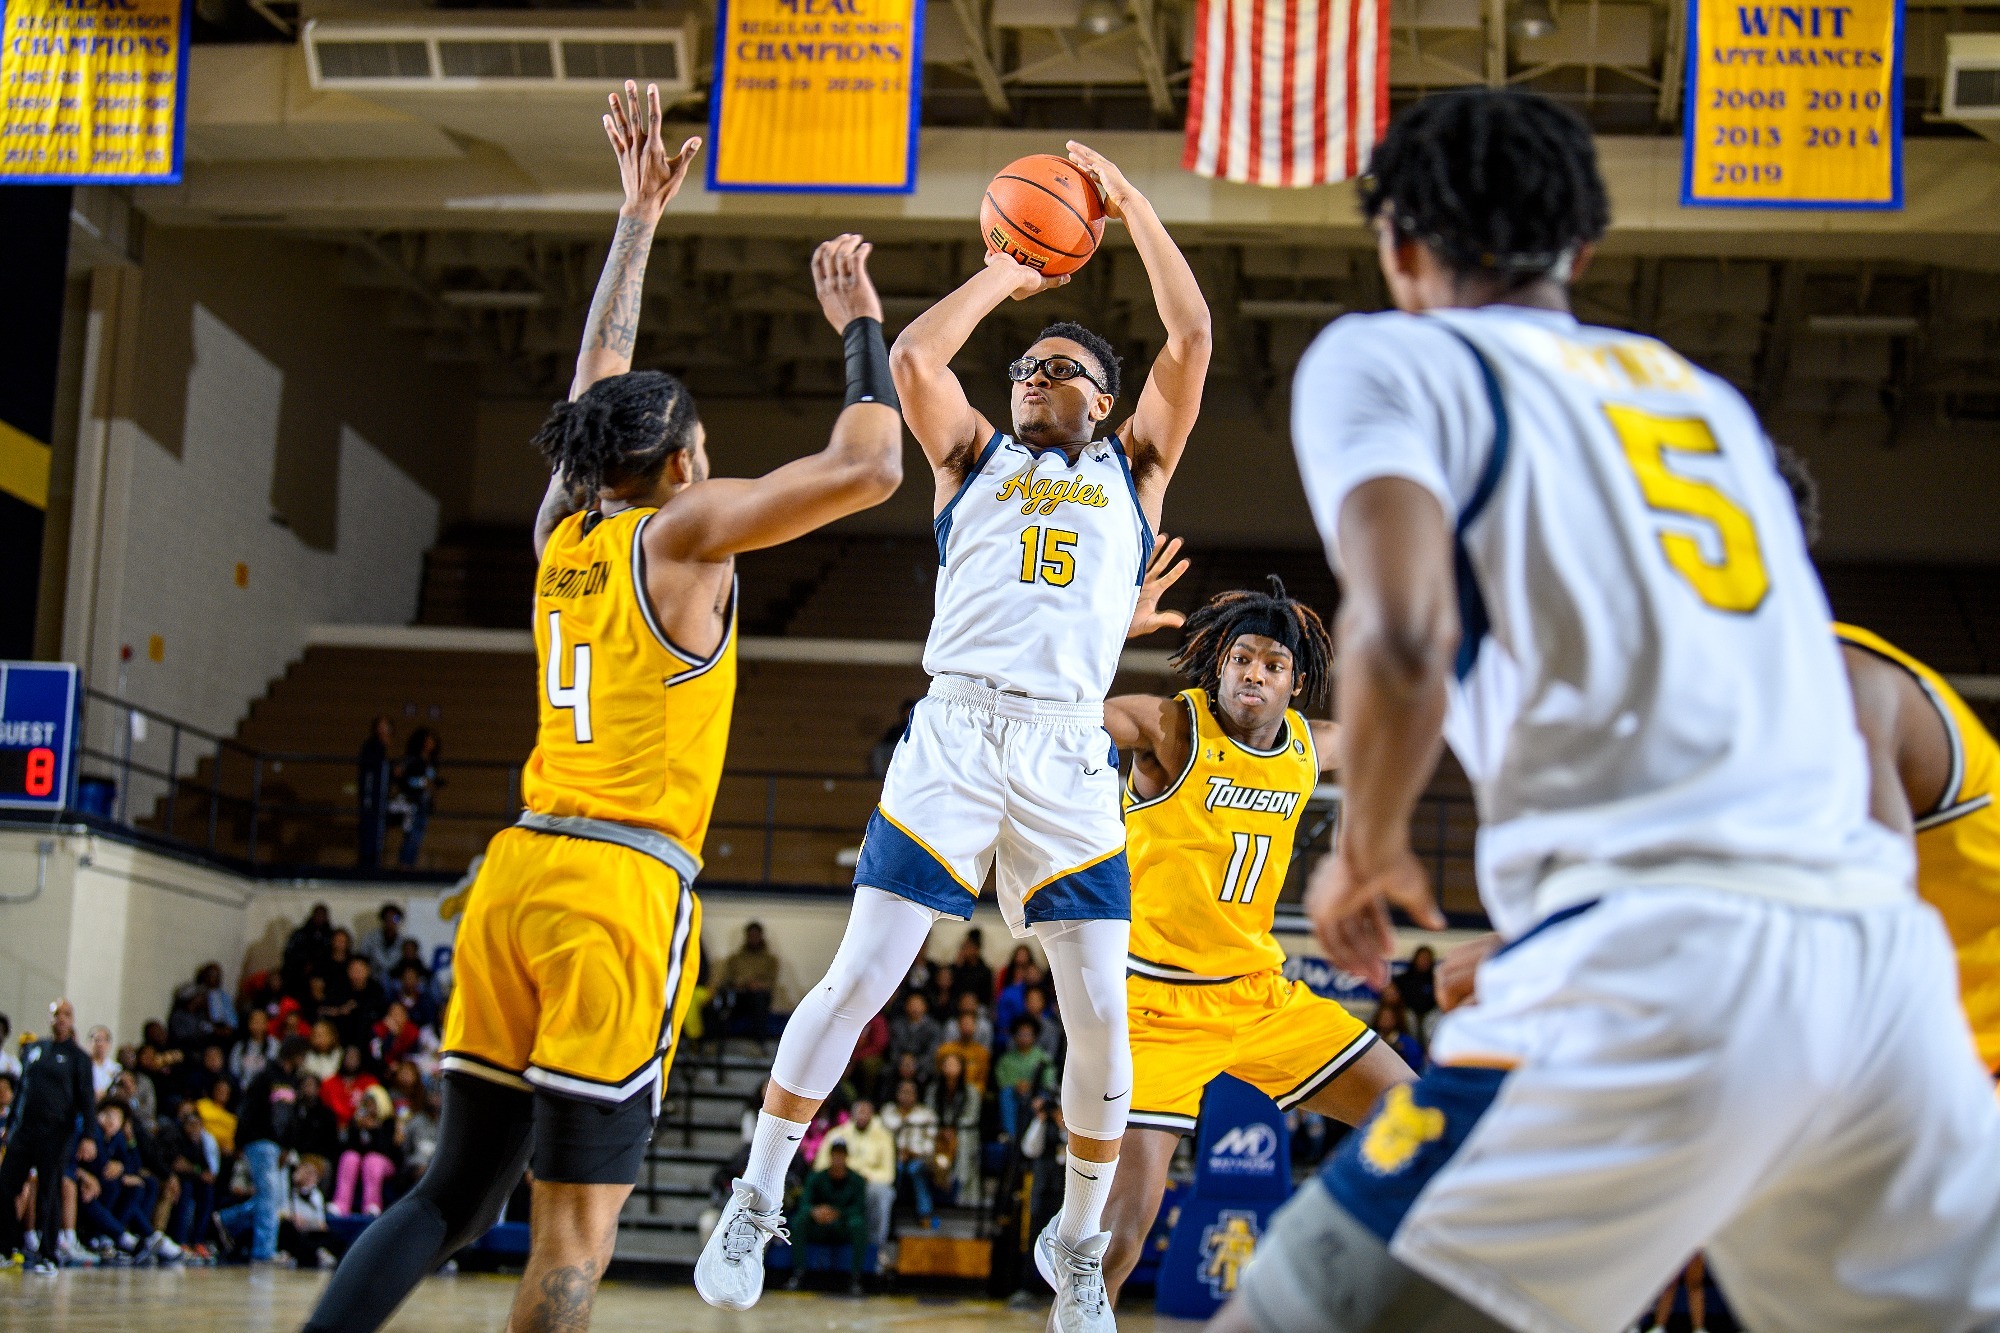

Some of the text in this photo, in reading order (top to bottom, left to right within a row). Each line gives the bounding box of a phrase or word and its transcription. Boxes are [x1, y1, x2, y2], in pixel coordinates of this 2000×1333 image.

[1737, 6, 1852, 38] WNIT
[13, 36, 171, 56] CHAMPIONS
[736, 42, 903, 62] CHAMPIONS
[1712, 48, 1883, 67] APPEARANCES
[1711, 88, 1882, 110] 2008 2010
[1712, 126, 1880, 148] 2013 2014
[1712, 163, 1783, 184] 2019
[996, 466, 1109, 515] Aggies
[1600, 401, 1771, 614] 5
[1020, 525, 1078, 588] 15
[547, 610, 593, 743] 4
[25, 747, 55, 796] 8
[1205, 776, 1300, 821] TOWSON
[1218, 832, 1272, 904] 11
